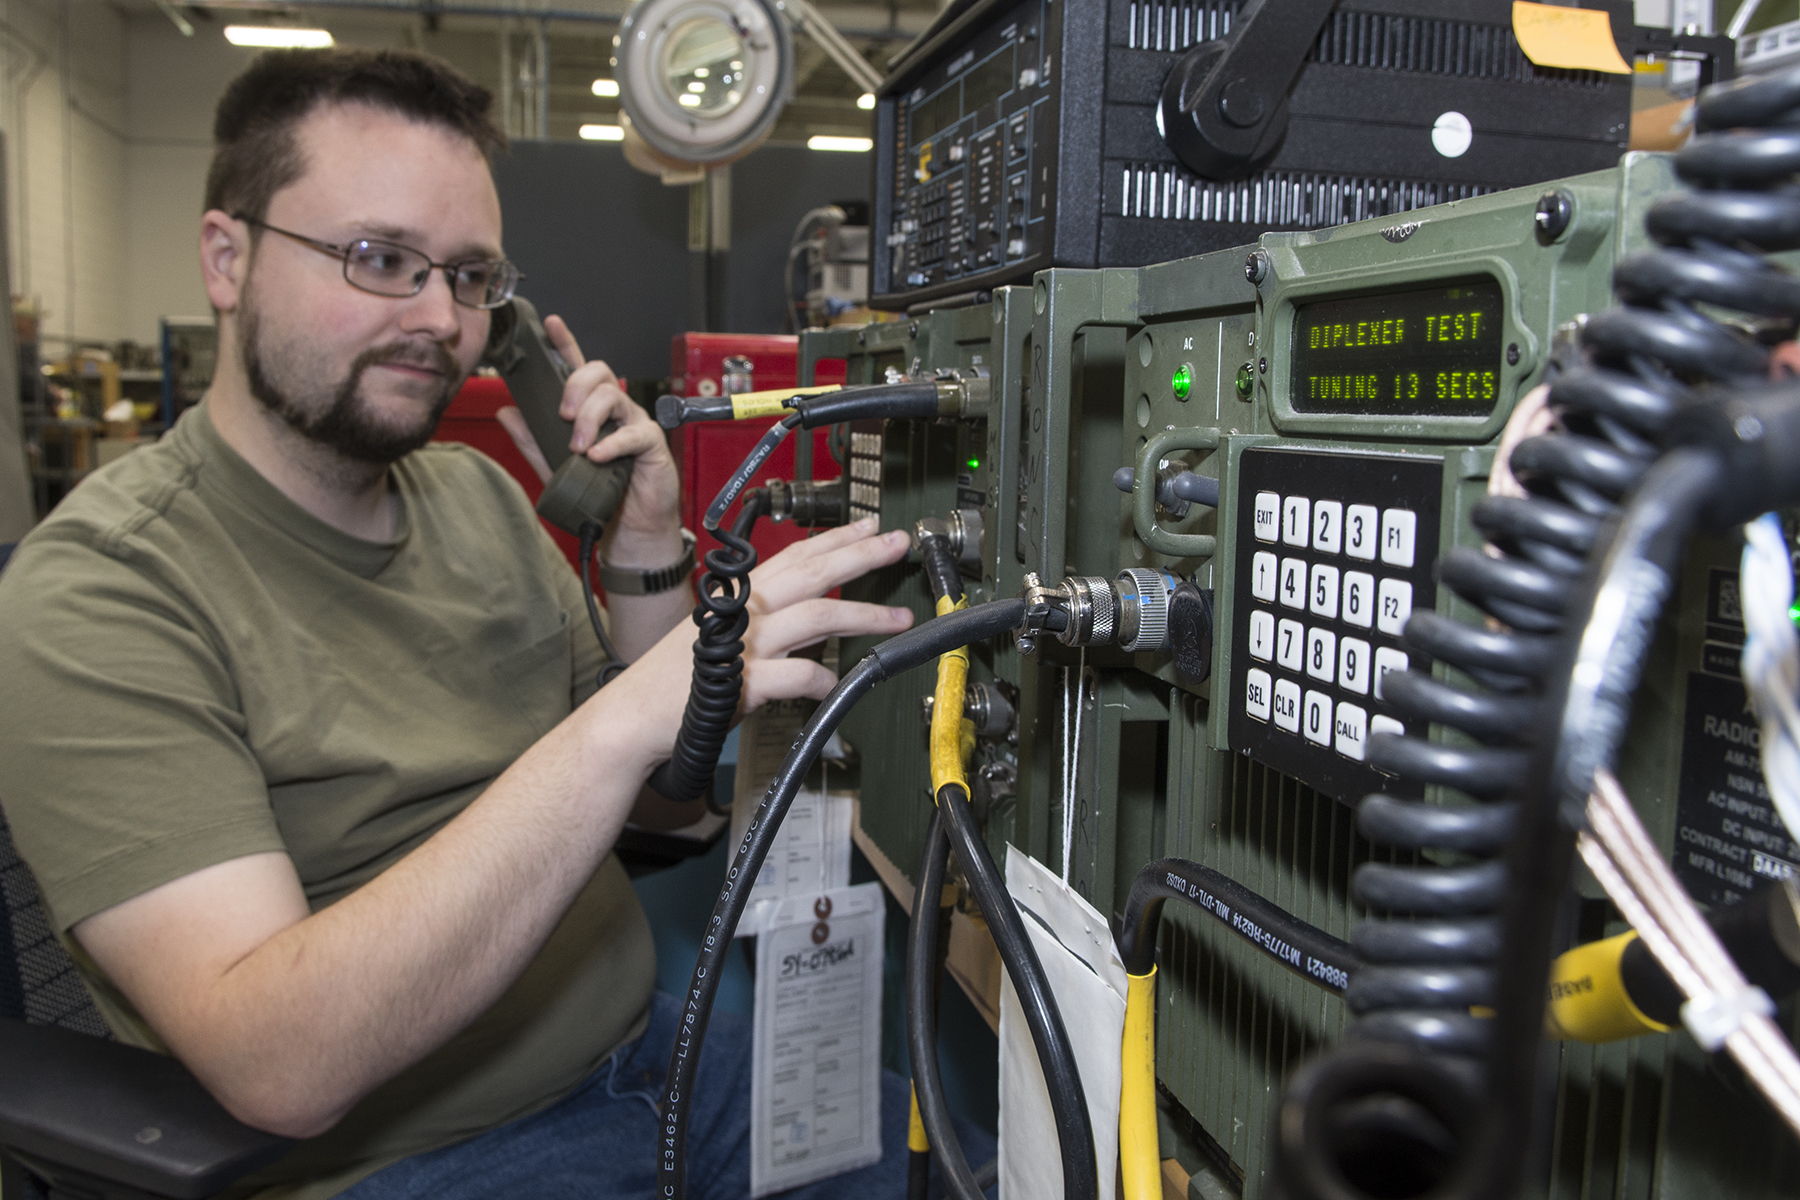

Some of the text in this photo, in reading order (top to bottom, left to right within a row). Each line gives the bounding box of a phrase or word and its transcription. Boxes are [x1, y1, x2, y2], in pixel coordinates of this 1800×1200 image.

[1425, 312, 1482, 342] TEST
[1183, 337, 1194, 351] AC
[1309, 371, 1495, 399] TUNING 13 SECS
[1256, 509, 1273, 526] EXIT
[1290, 505, 1297, 537] 1
[1319, 510, 1330, 543] 2
[1352, 515, 1363, 548] 3
[1388, 527, 1401, 549] F1
[1285, 568, 1296, 599] 4
[1316, 574, 1327, 607] 5
[1350, 583, 1360, 615] 6
[1384, 598, 1399, 618] F2
[1283, 630, 1293, 659] 7
[1313, 639, 1324, 670] 8
[1346, 649, 1356, 681] 9
[1248, 683, 1265, 707] SEL
[1275, 693, 1295, 719] CLR
[1336, 719, 1360, 742] CALL
[704, 915, 722, 953] 18-3
[721, 867, 738, 902] SJO
[1188, 884, 1231, 921] MIL-DTL-17
[1232, 912, 1301, 967] M17/75-RG214
[1306, 956, 1349, 990] 988421
